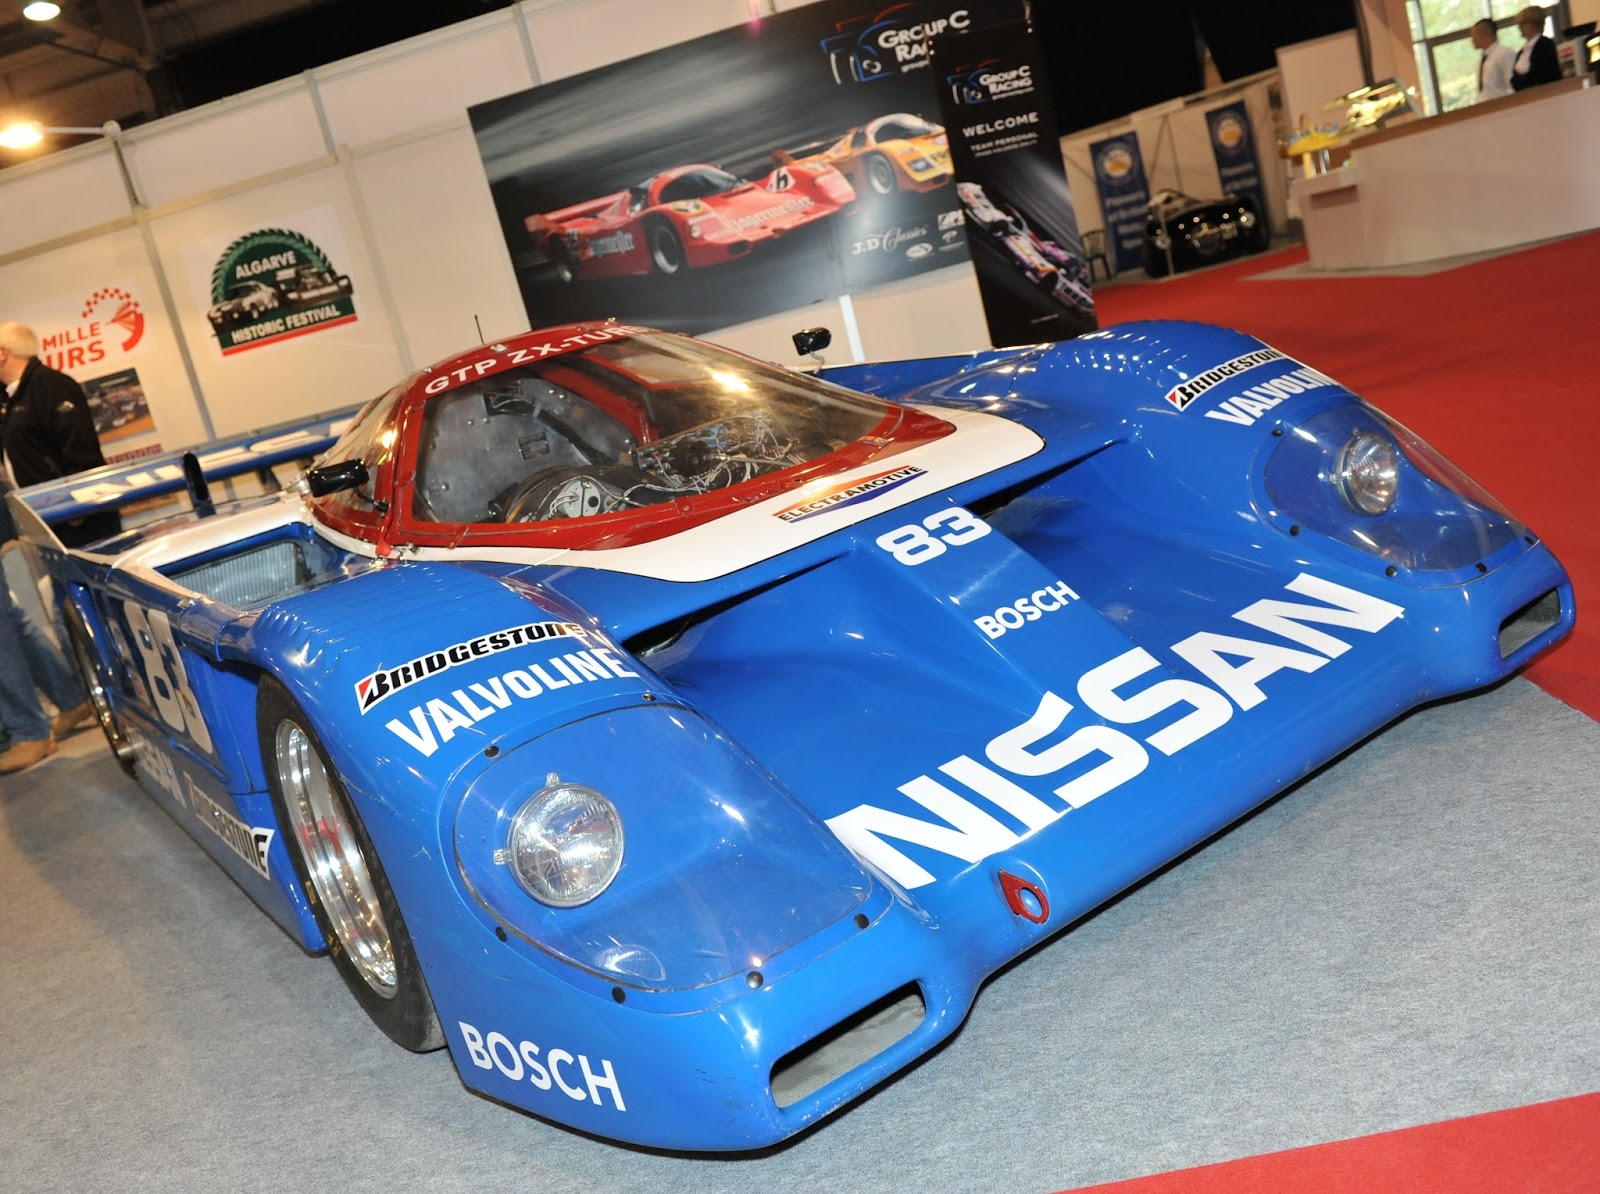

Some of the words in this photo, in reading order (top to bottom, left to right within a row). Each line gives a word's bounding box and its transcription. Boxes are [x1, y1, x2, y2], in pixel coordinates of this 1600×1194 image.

[878, 19, 948, 49] GROUP
[948, 9, 971, 29] C
[961, 111, 1040, 138] WELCOME
[235, 250, 297, 280] ALGARVE
[42, 321, 101, 352] MILLE
[231, 317, 286, 345] HISTORIC
[285, 303, 342, 330] FESTIVAL
[424, 358, 498, 395] GTP
[777, 465, 923, 522] ELECTRAMOTIVE
[876, 506, 993, 567] 83
[973, 580, 1081, 640] BOSCH
[123, 600, 213, 754] 83
[356, 621, 588, 714] BRIDGESTONE
[385, 648, 641, 758] VALVOLINE
[824, 571, 1405, 890] NISSAN
[458, 1020, 627, 1112] BOSCH
